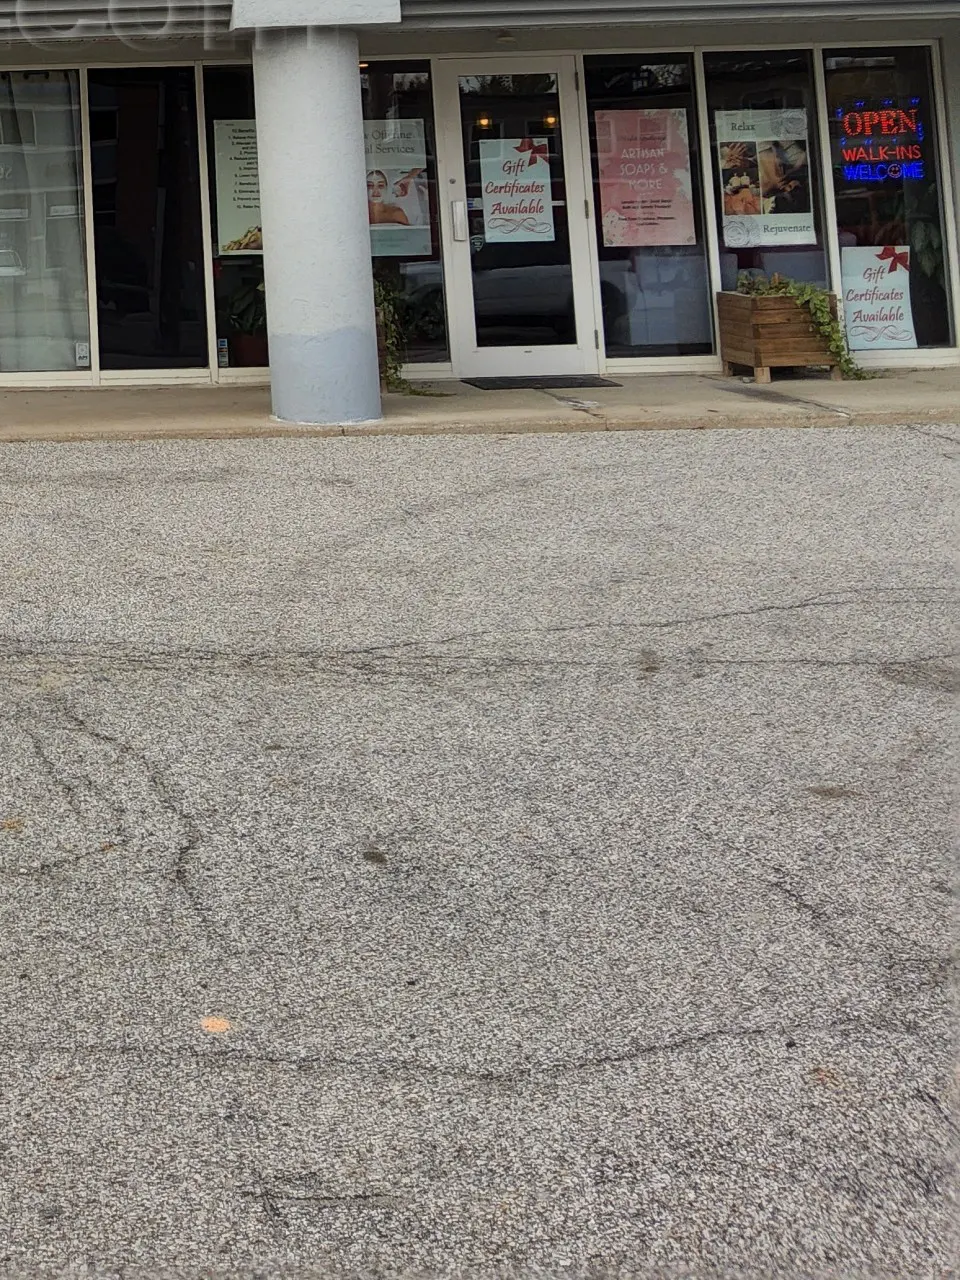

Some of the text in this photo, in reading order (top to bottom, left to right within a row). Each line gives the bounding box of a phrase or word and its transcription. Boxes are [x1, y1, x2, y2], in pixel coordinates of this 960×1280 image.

[731, 122, 756, 131] Relax
[843, 109, 918, 136] OPEN
[375, 143, 415, 154] Services
[621, 147, 665, 159] ARTISAN
[842, 145, 922, 161] WALK-INS
[502, 158, 525, 176] Gift
[620, 163, 655, 176] SOAPS
[485, 181, 545, 197] Certificates
[490, 198, 545, 216] Available
[763, 224, 812, 235] Rejuvenate
[863, 265, 887, 284] Gift
[846, 286, 904, 305] Certificates
[852, 306, 905, 322] Available
